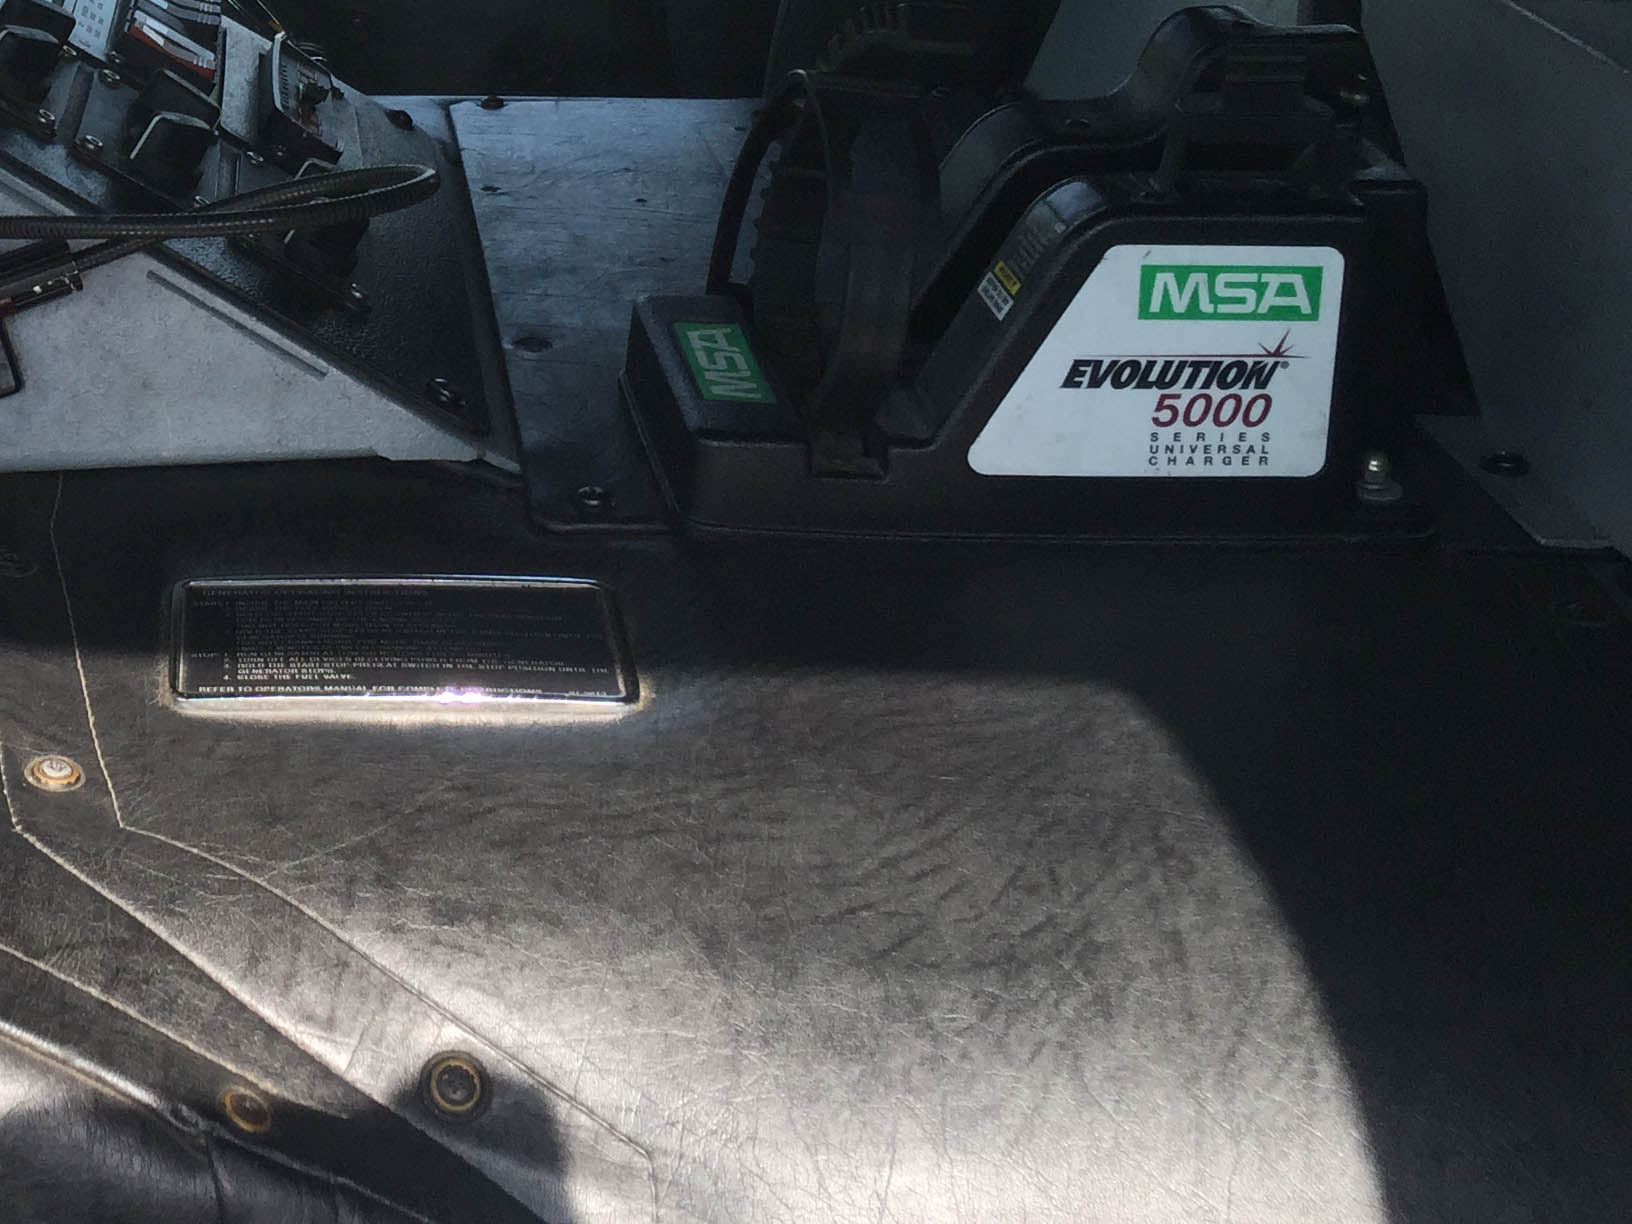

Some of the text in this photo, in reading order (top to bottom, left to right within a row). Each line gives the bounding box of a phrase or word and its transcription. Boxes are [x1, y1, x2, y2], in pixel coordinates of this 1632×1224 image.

[1149, 272, 1313, 314] MSA
[686, 327, 762, 400] MSA
[1059, 359, 1283, 390] EVOLUTION
[1151, 393, 1273, 428] 5000
[1149, 445, 1270, 455] UNIVERSAL
[1150, 431, 1272, 443] SERIES
[1148, 456, 1269, 467] CHARGER
